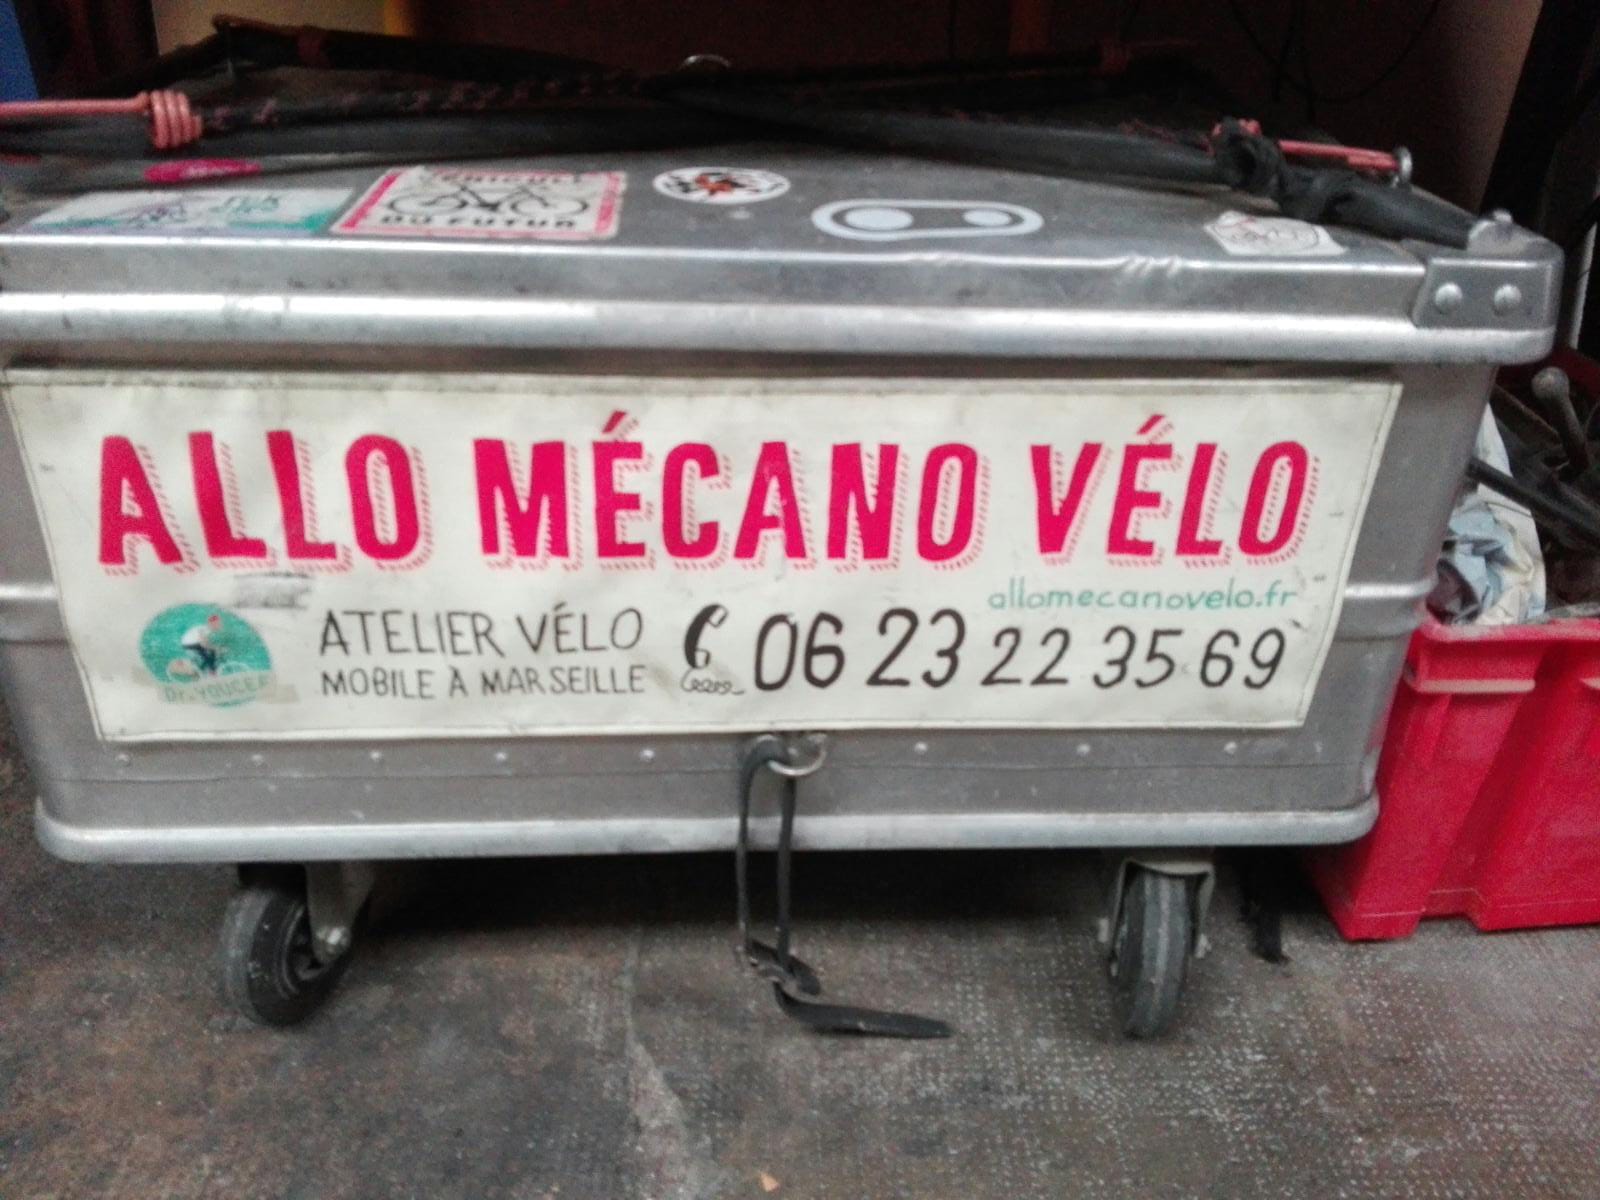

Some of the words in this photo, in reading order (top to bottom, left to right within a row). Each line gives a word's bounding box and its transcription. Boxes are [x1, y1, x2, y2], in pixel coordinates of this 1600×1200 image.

[99, 430, 430, 567] ALLO
[473, 411, 985, 565] MÉCANO
[1030, 414, 1314, 562] VÉLO
[987, 576, 1298, 610] allomecanovelo.fr
[320, 609, 506, 657] ATELIER
[515, 601, 643, 654] VÉLO
[753, 611, 846, 692] 06
[865, 607, 967, 689] 23
[980, 626, 1071, 687] 22
[1092, 625, 1183, 690] 35
[1199, 626, 1286, 690] 69
[320, 668, 437, 699] MOBILE
[480, 664, 647, 696] MARSEILLE
